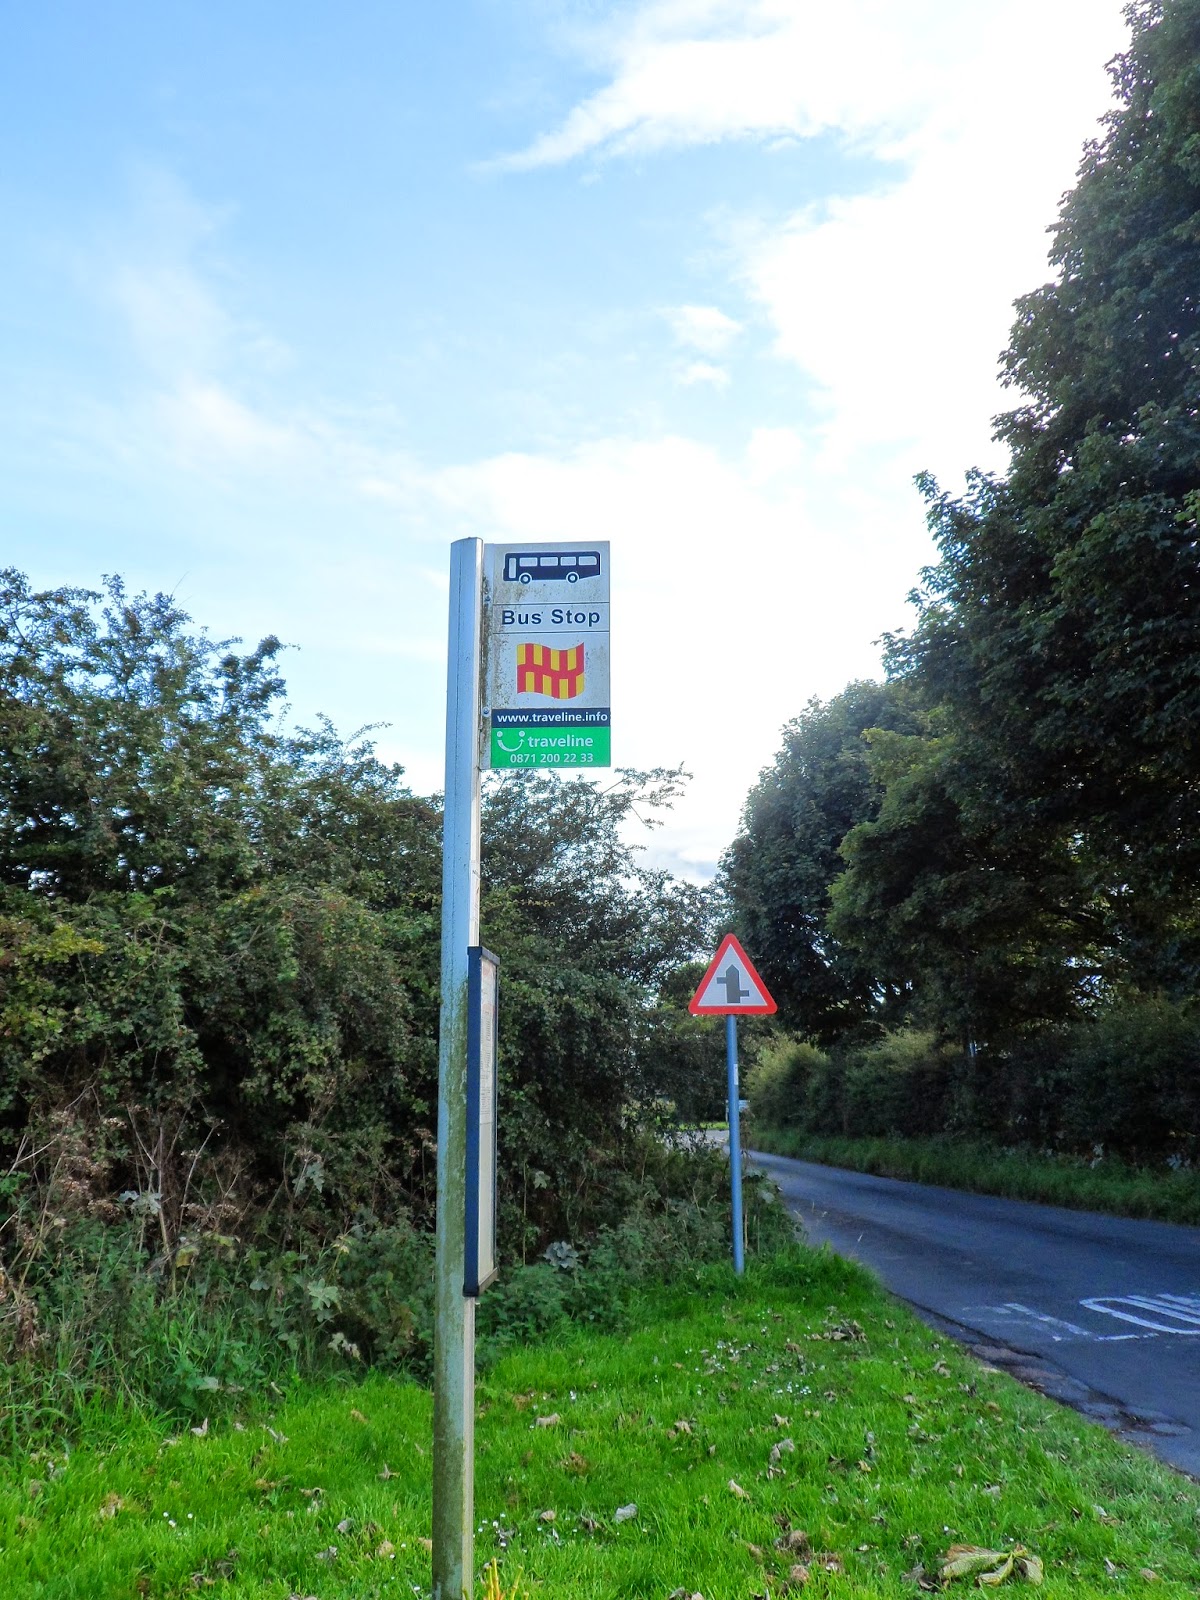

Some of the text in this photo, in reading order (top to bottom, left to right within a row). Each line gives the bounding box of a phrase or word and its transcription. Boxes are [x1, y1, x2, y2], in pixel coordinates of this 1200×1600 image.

[501, 608, 600, 627] Bus Stop
[496, 712, 608, 723] www.traveline.info
[527, 735, 593, 747] traveline
[509, 753, 594, 764] 0871 200 22 33
